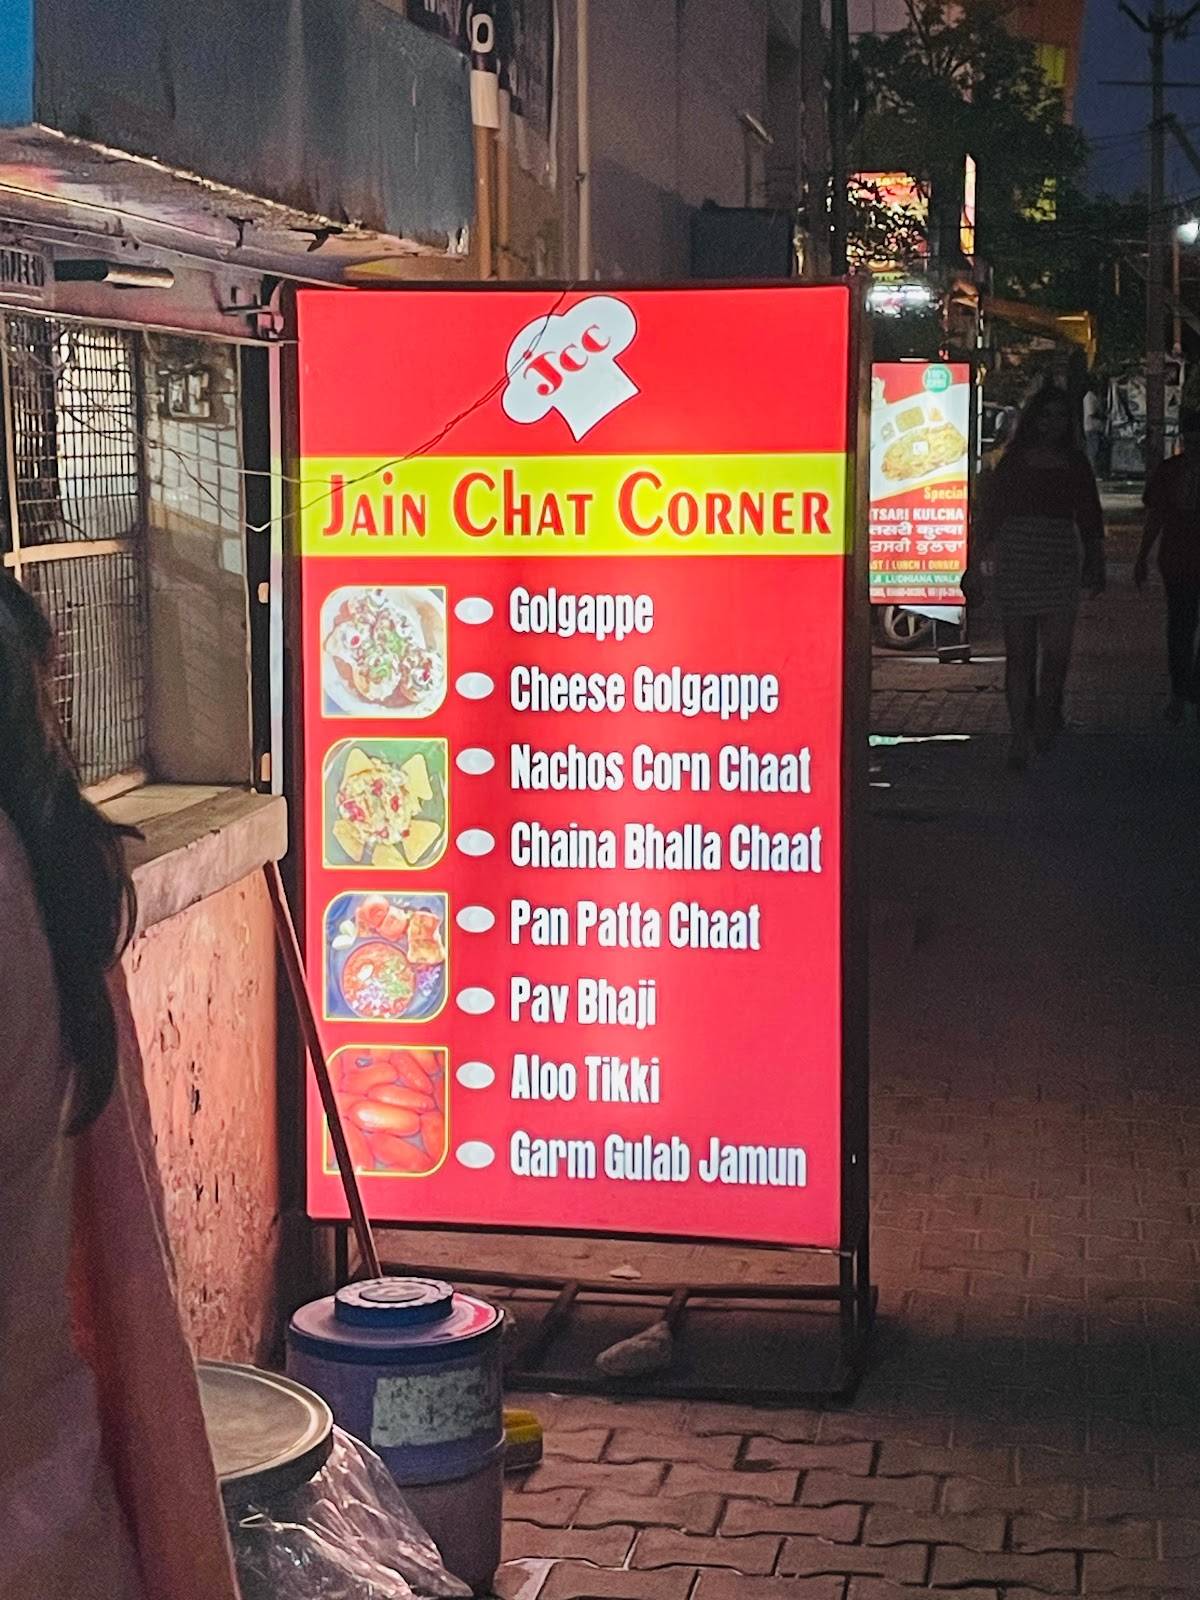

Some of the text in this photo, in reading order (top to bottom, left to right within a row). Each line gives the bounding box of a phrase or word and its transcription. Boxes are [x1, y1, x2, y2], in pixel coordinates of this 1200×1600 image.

[913, 508, 965, 520] KULCHA
[509, 586, 655, 641] Golgappe
[509, 666, 780, 720] Cheese Golgappe
[510, 744, 812, 794] Nachos Corn Chaat
[510, 821, 823, 873] Chaina Bhalla Chaat
[510, 899, 761, 951] Pan Patta Chaat
[510, 976, 657, 1031] Pav Bhaji
[510, 1053, 661, 1104] Aloo Tikki
[510, 1130, 808, 1187] Garm Gulab Jamun
